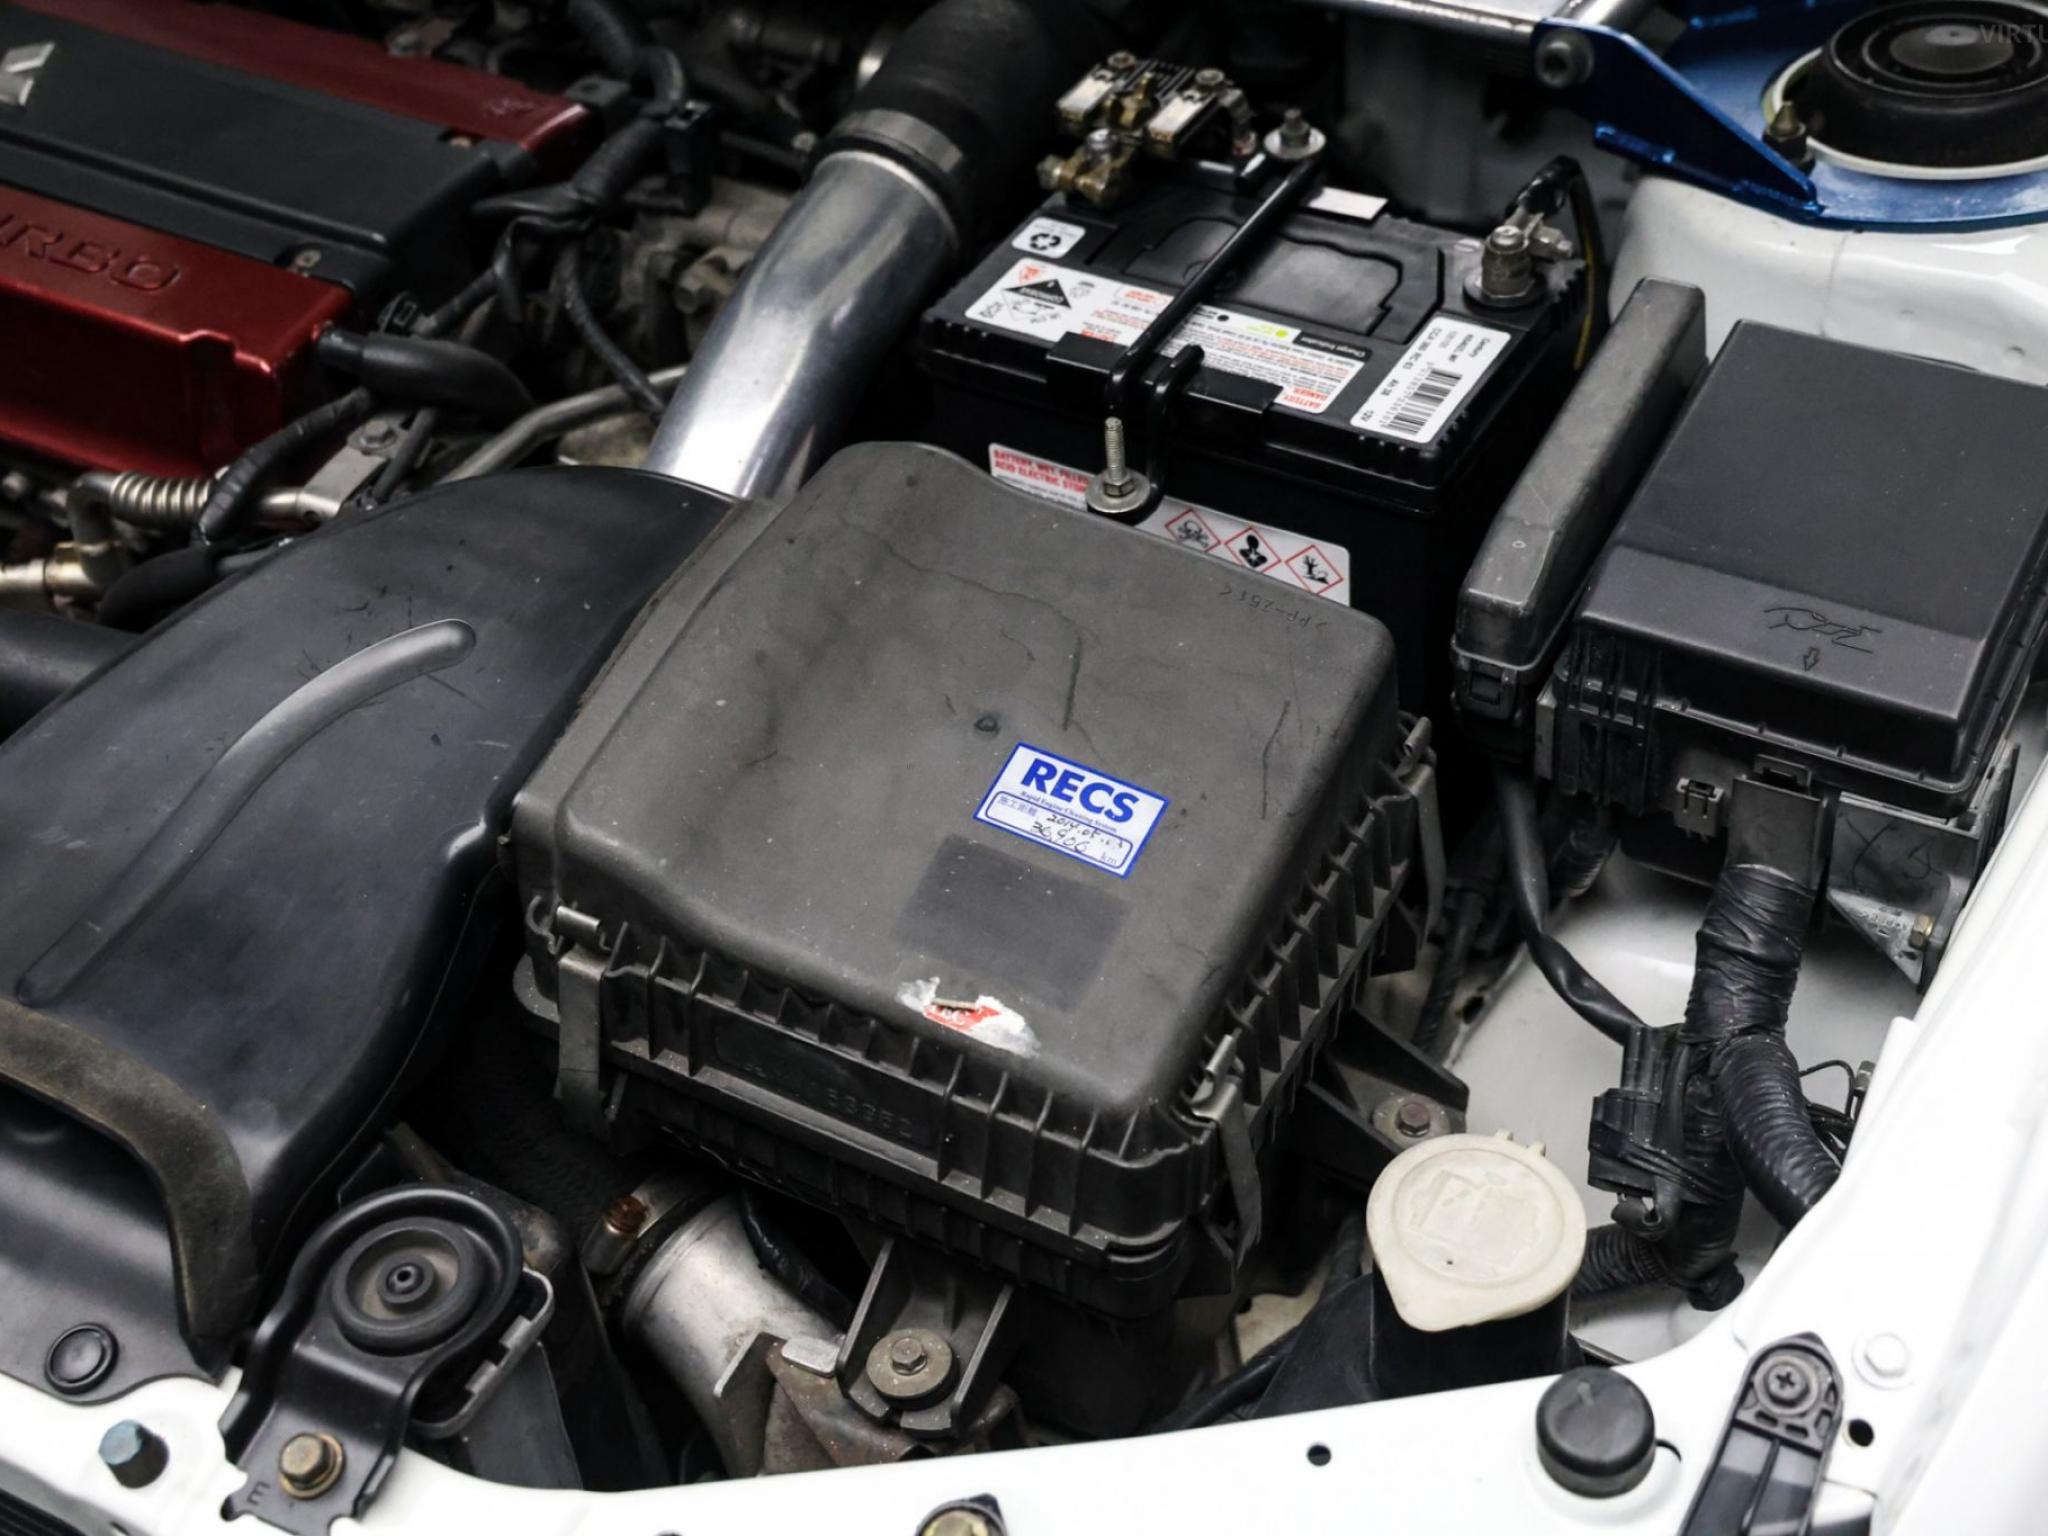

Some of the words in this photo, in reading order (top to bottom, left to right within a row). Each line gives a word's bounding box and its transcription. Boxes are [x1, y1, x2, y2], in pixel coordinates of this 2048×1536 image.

[0, 214, 182, 292] RBO
[1021, 758, 1139, 823] RECS
[246, 1480, 271, 1505] E
